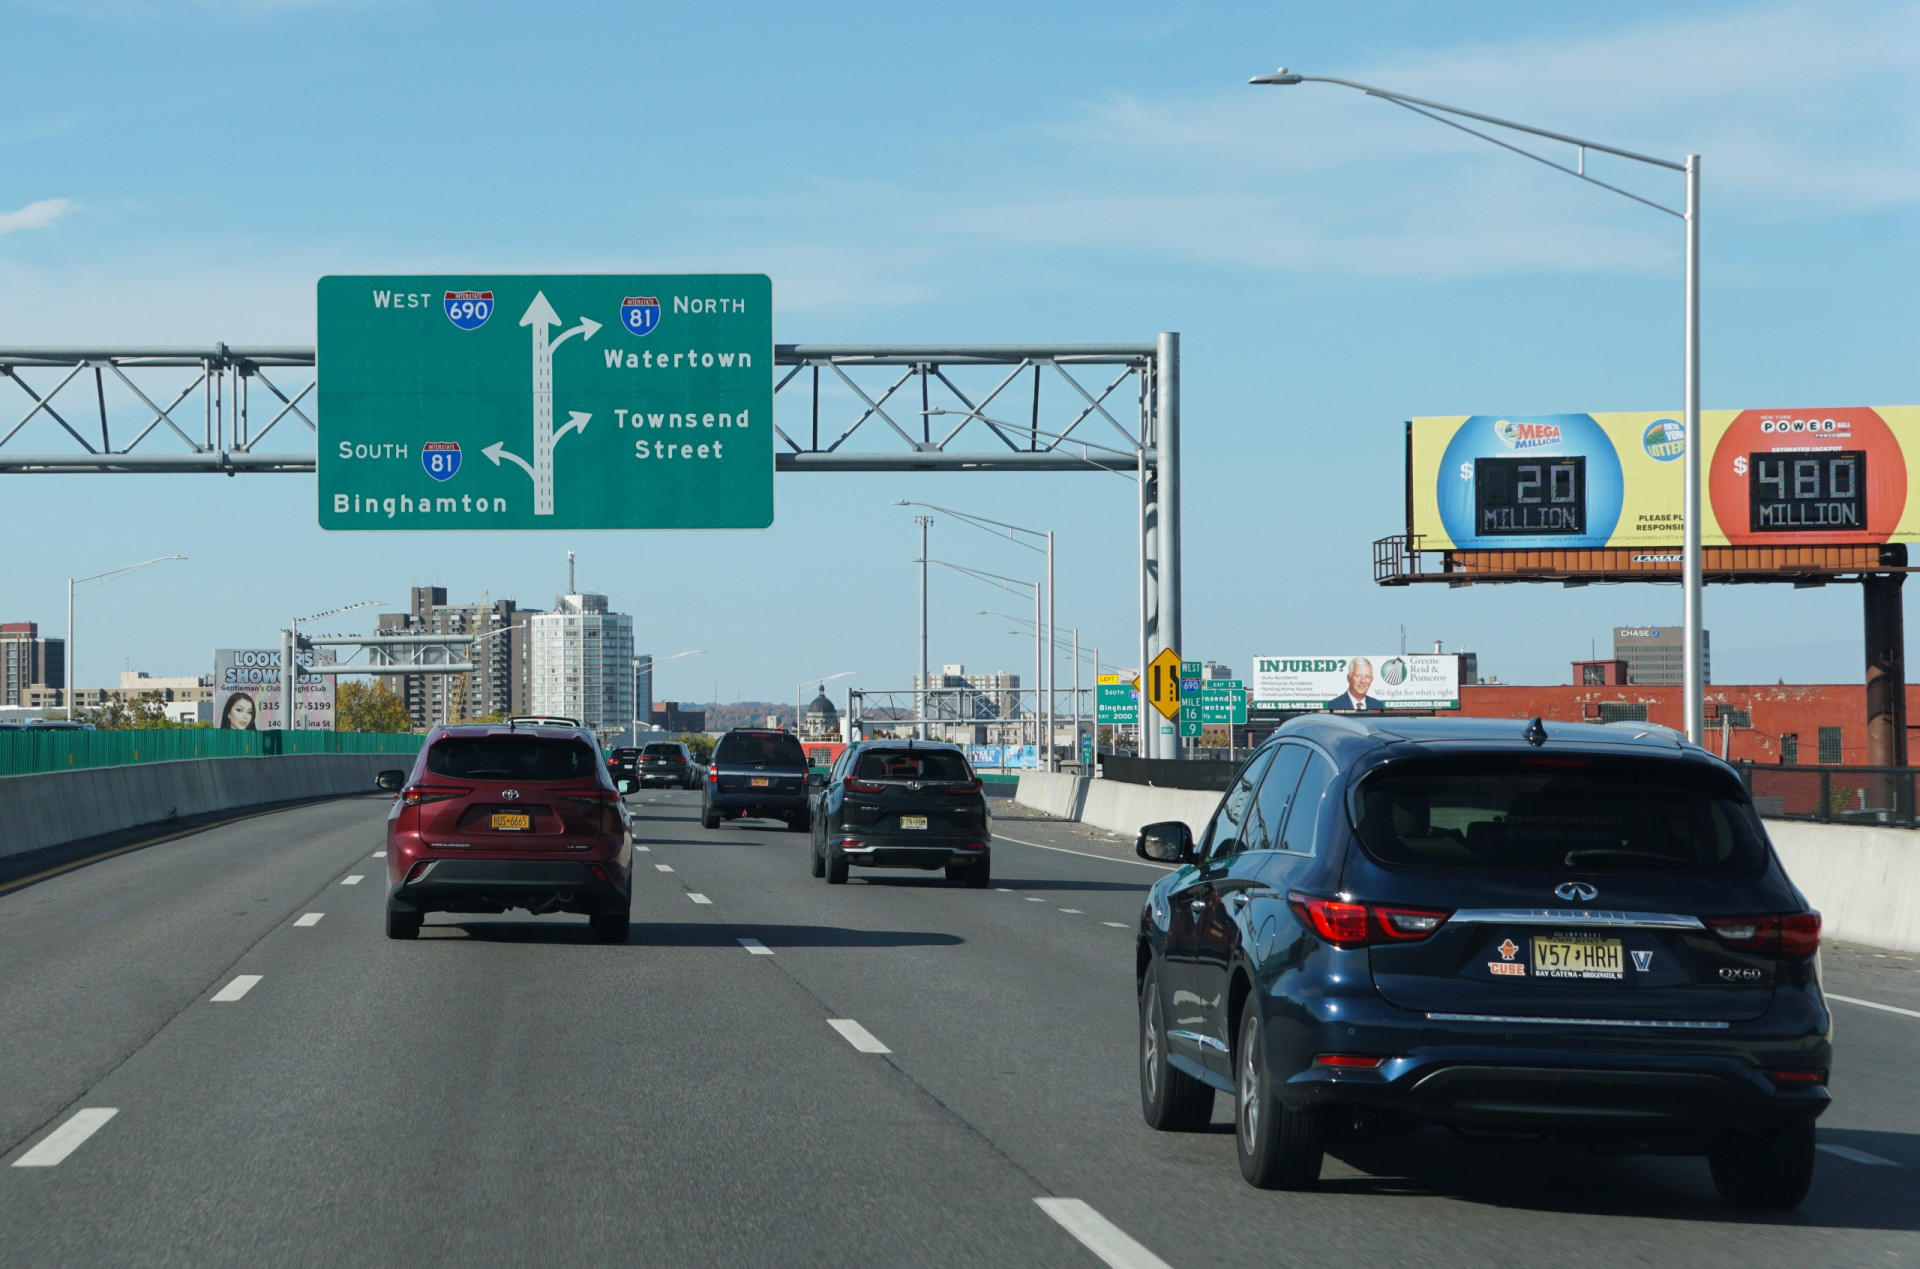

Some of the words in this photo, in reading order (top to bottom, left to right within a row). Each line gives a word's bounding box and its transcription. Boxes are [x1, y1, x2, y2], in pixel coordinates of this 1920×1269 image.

[373, 290, 431, 309] WEST
[450, 301, 488, 320] 690
[629, 308, 652, 328] 81
[673, 295, 745, 314] NORTH
[604, 349, 752, 368] Watertown
[614, 409, 750, 428] Townsend
[1518, 423, 1561, 440] MEGA
[1663, 423, 1680, 431] NEW
[635, 439, 724, 460] Street
[1515, 438, 1561, 450] MILLIONS
[1647, 441, 1685, 457] LOTTER
[1771, 446, 1811, 454] ESTIMATED
[1811, 445, 1843, 453] JACKPOT
[338, 440, 409, 459] SOUTH
[431, 453, 453, 473] 81
[1518, 464, 1575, 504] 20
[1758, 459, 1856, 499] 480
[333, 493, 508, 519] Binghamton
[1484, 507, 1576, 530] MILLION
[1759, 502, 1856, 526] MILLION
[1621, 629, 1650, 637] CHASE
[234, 651, 315, 668] LOOKRS
[1258, 659, 1347, 673] INJURED?
[1410, 656, 1441, 665] Greene
[1182, 663, 1200, 673] WEST
[1410, 665, 1429, 673] Reid
[1431, 665, 1439, 673] &
[1410, 673, 1447, 683] Pomeroy
[1183, 681, 1199, 690] 690
[1387, 688, 1403, 698] fight
[1404, 688, 1414, 696] for
[1415, 688, 1436, 696] what's
[1437, 688, 1453, 698] right
[1099, 704, 1138, 713] Binghamt
[1182, 697, 1201, 707] MILE
[1186, 708, 1197, 720] 16
[1550, 970, 1578, 978] CATENA
[1718, 967, 1762, 982] QX60
